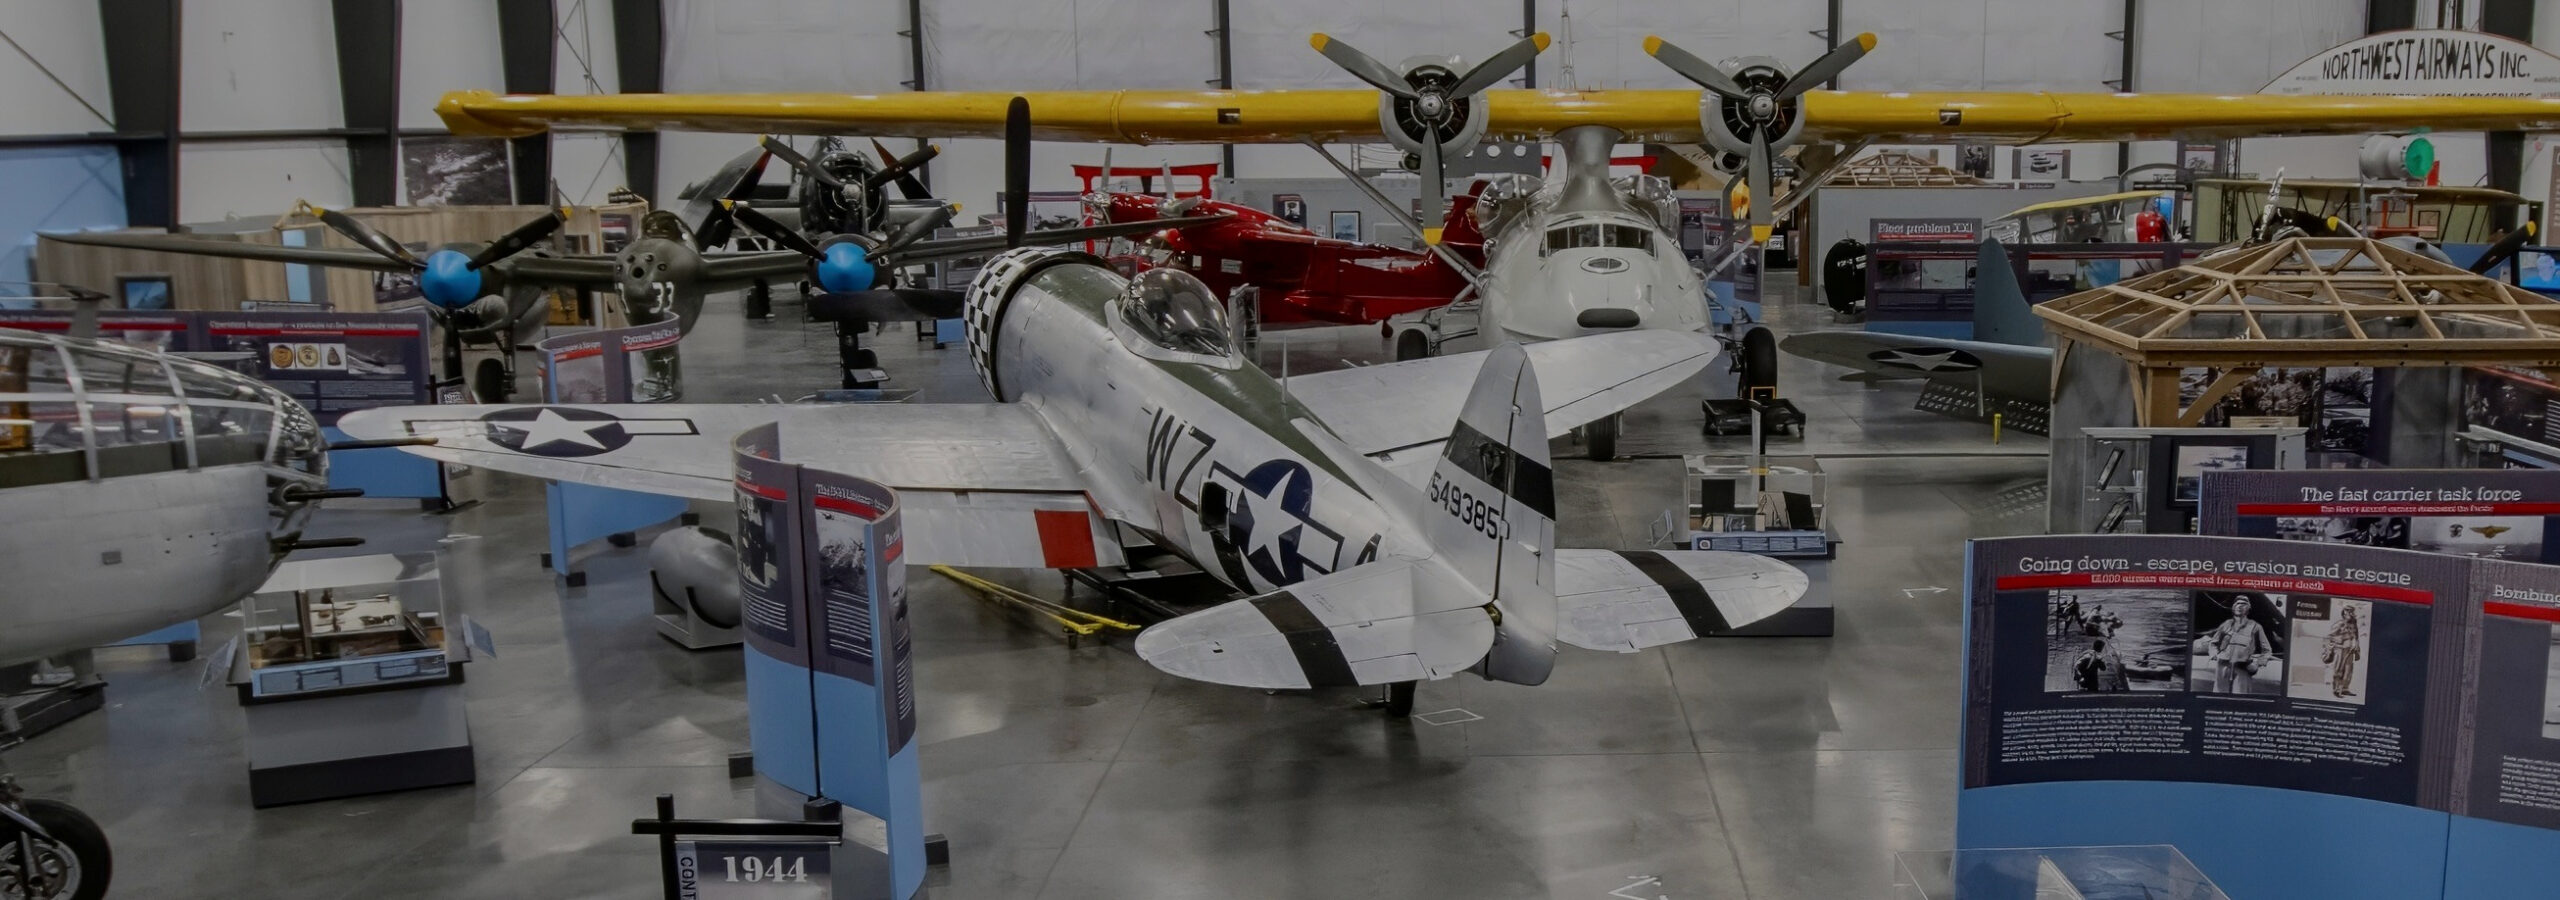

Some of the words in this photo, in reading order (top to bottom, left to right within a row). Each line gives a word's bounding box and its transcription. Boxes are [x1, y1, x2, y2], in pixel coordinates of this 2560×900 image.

[2322, 38, 2414, 80] NORTHWEST
[2415, 38, 2496, 80] AIRWAYS
[2499, 50, 2531, 79] INC.
[1906, 222, 1951, 236] problem
[1430, 470, 1501, 540] 549385
[2300, 486, 2333, 502] The
[2338, 486, 2369, 502] fast
[2373, 487, 2433, 502] carrier
[2437, 486, 2473, 502] task
[2476, 486, 2522, 502] force
[2019, 556, 2073, 575] Going
[2077, 555, 2130, 571] down
[2147, 558, 2218, 575] escape,
[2224, 560, 2298, 576] evasion
[2303, 563, 2340, 578] and
[2344, 567, 2412, 585] rescue
[722, 855, 809, 883] 1944
